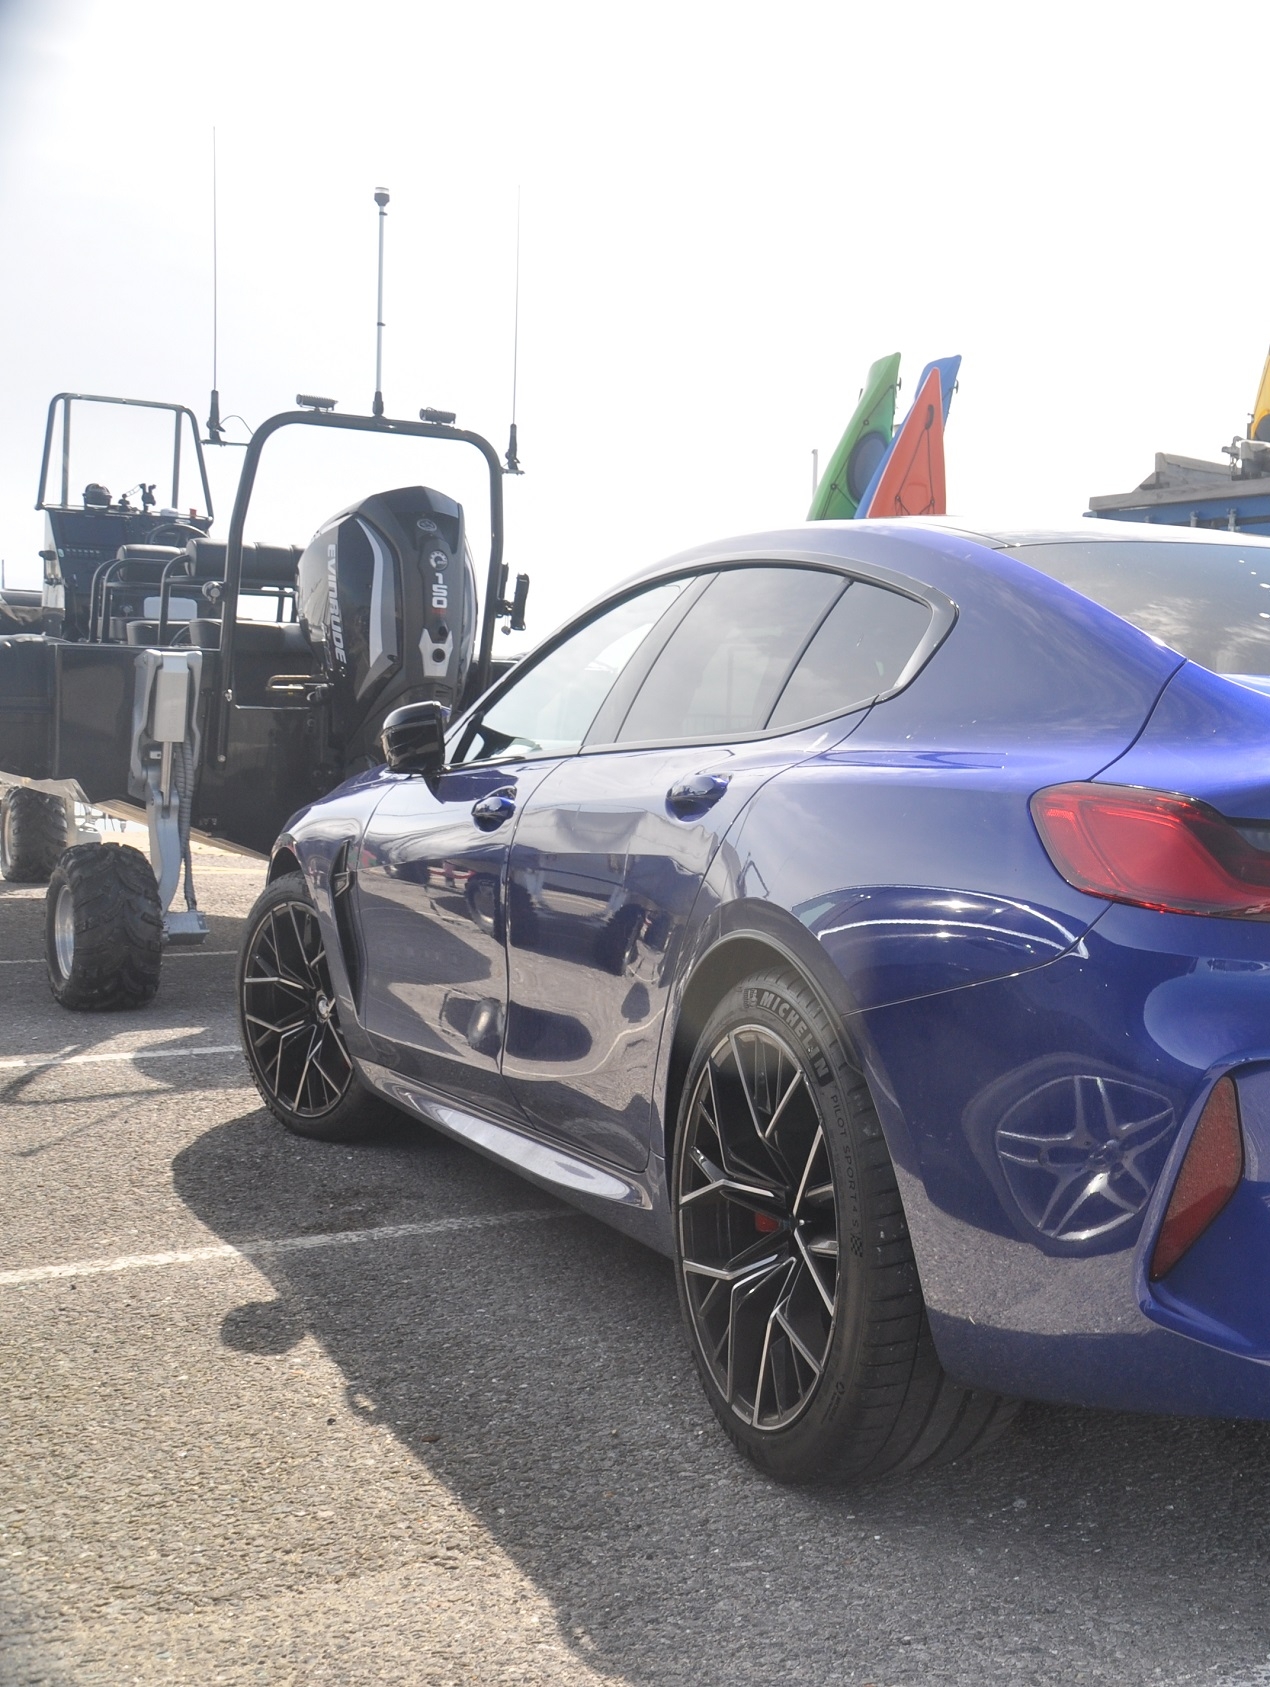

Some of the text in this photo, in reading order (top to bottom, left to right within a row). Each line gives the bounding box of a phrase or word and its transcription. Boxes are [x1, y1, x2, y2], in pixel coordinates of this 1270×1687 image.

[327, 543, 347, 664] EVINRUDE
[432, 572, 448, 609] 150
[760, 991, 830, 1078] MICHELIN
[830, 1094, 848, 1137] PILOT
[843, 1145, 857, 1200] SPORT
